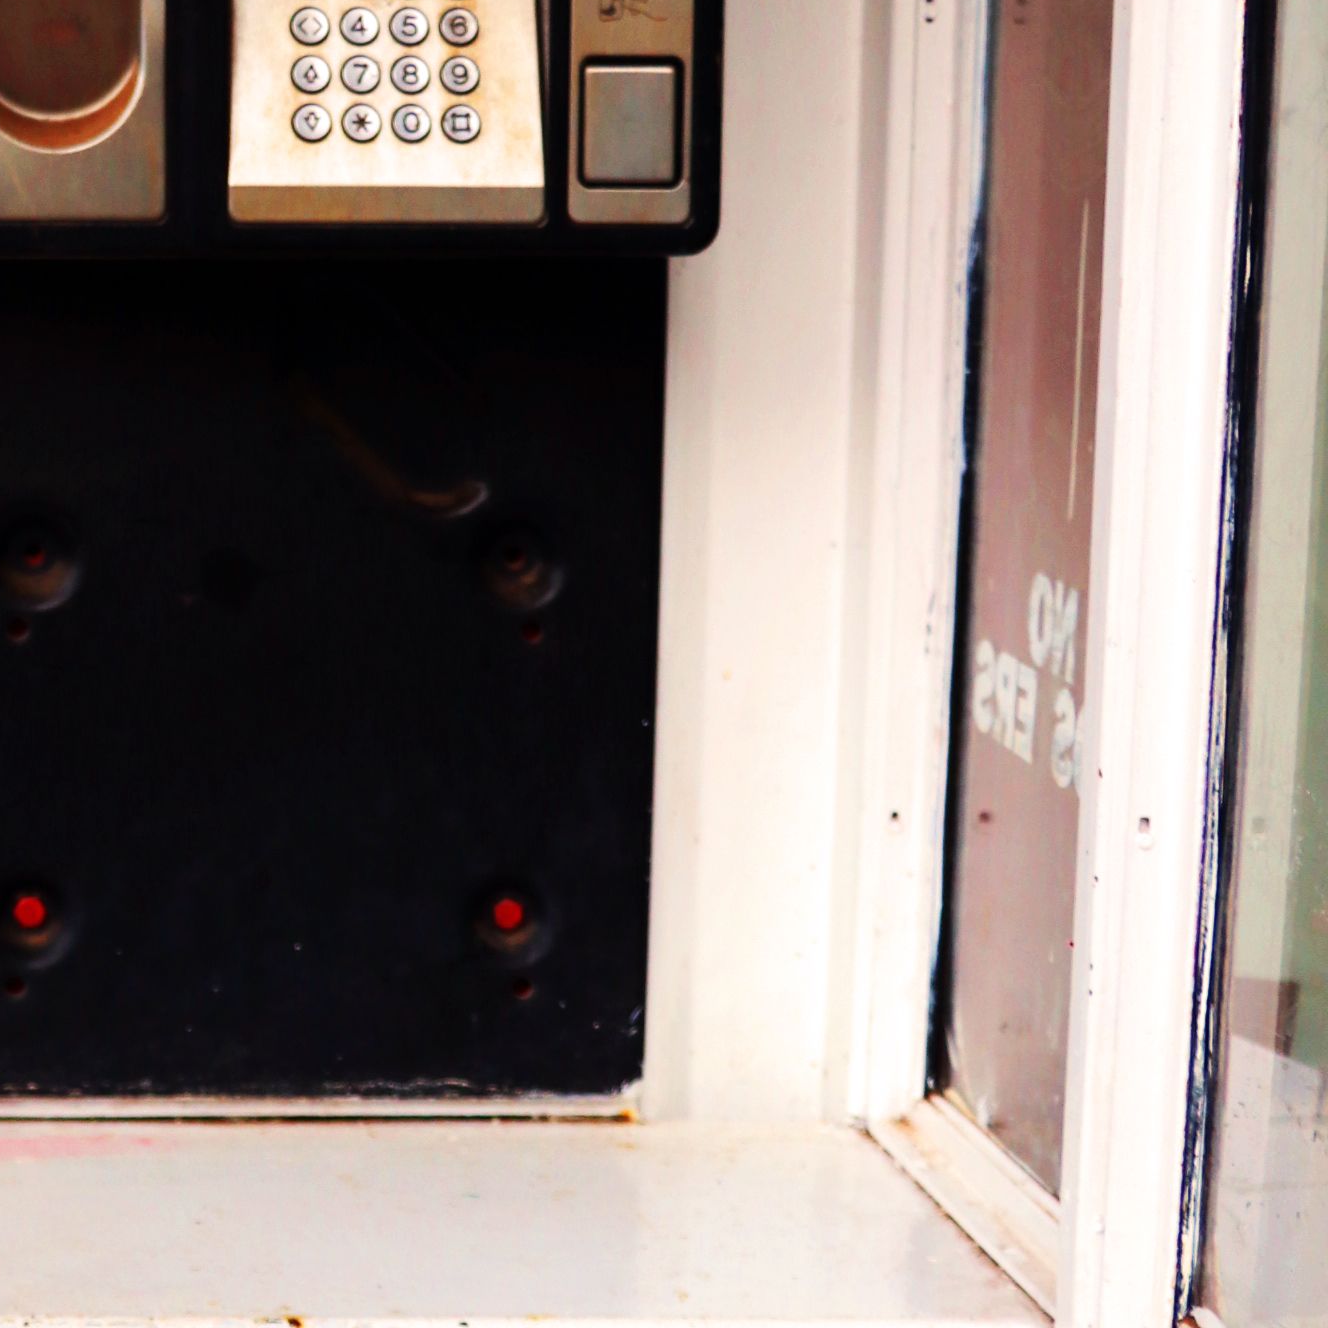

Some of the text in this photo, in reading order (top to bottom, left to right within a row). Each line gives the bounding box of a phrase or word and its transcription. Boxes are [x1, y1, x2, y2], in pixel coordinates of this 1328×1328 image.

[350, 15, 468, 37] 4 5 6
[353, 63, 469, 85] 7 8 9
[403, 111, 420, 134] 0
